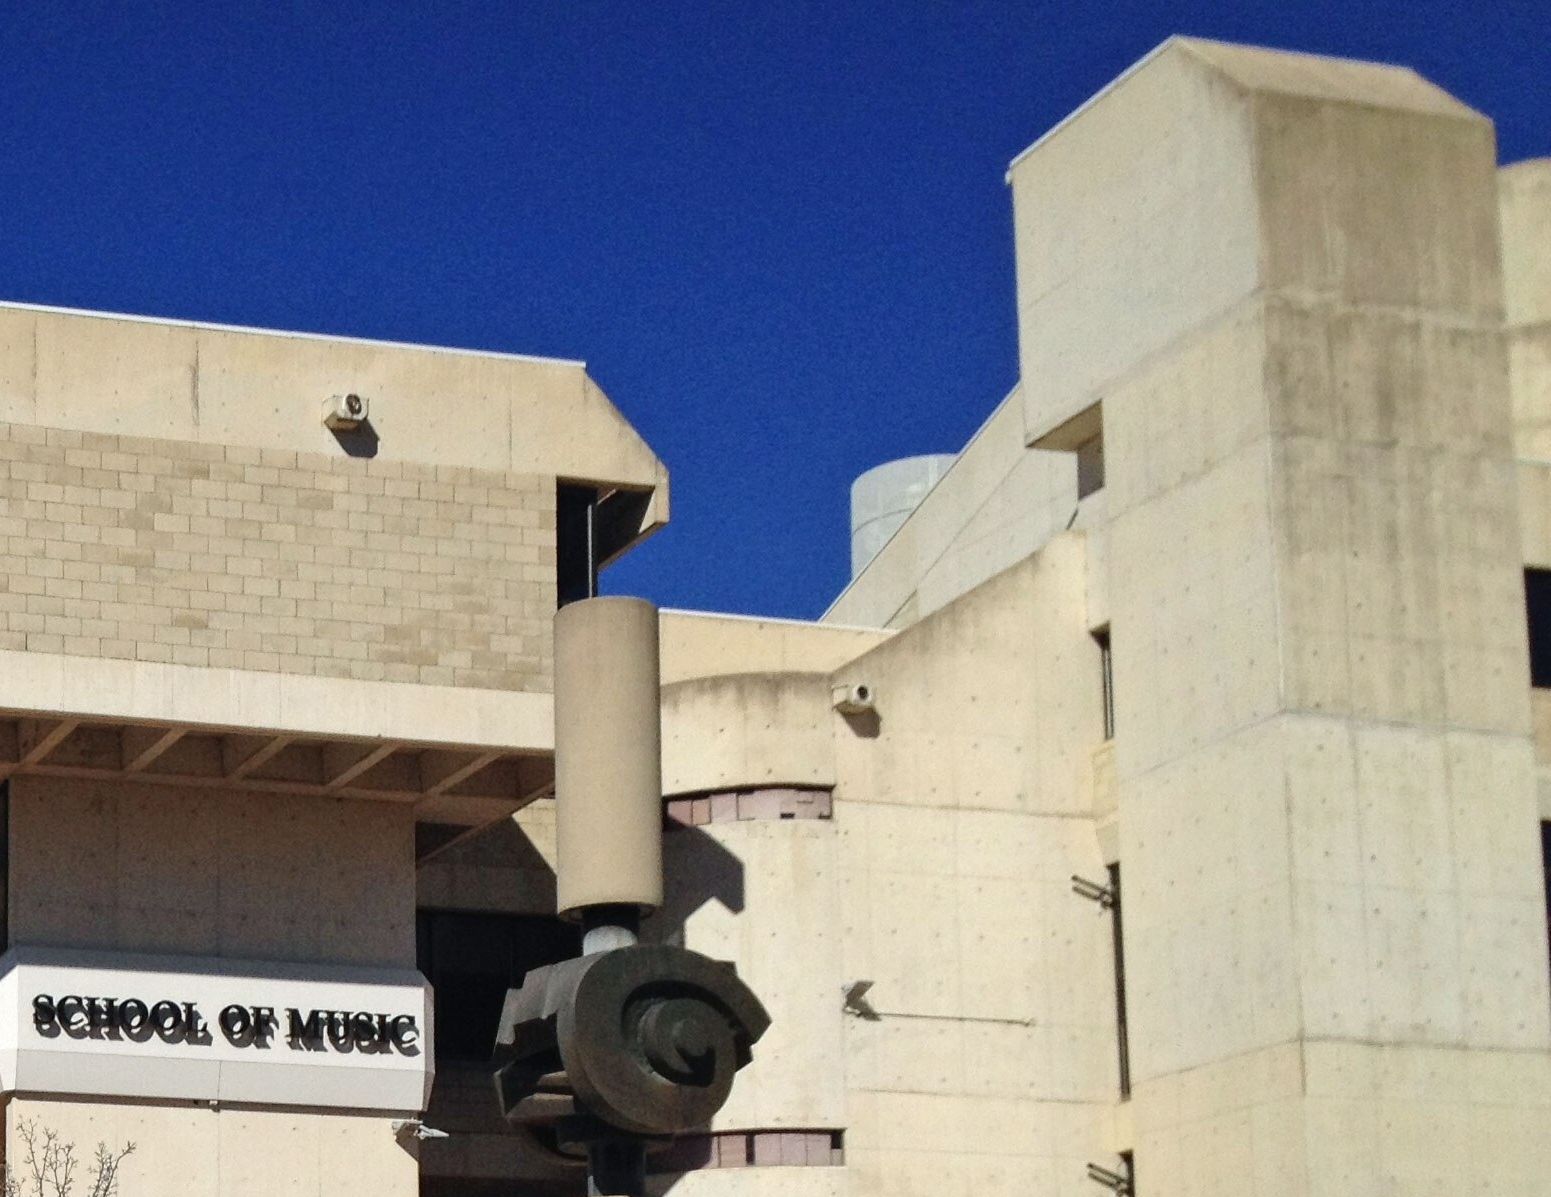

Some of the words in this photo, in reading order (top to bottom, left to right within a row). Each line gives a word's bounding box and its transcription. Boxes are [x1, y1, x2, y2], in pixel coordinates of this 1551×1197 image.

[33, 994, 210, 1040] SCHOOL
[219, 1004, 277, 1044] OF
[286, 1008, 420, 1052] MUSIC
